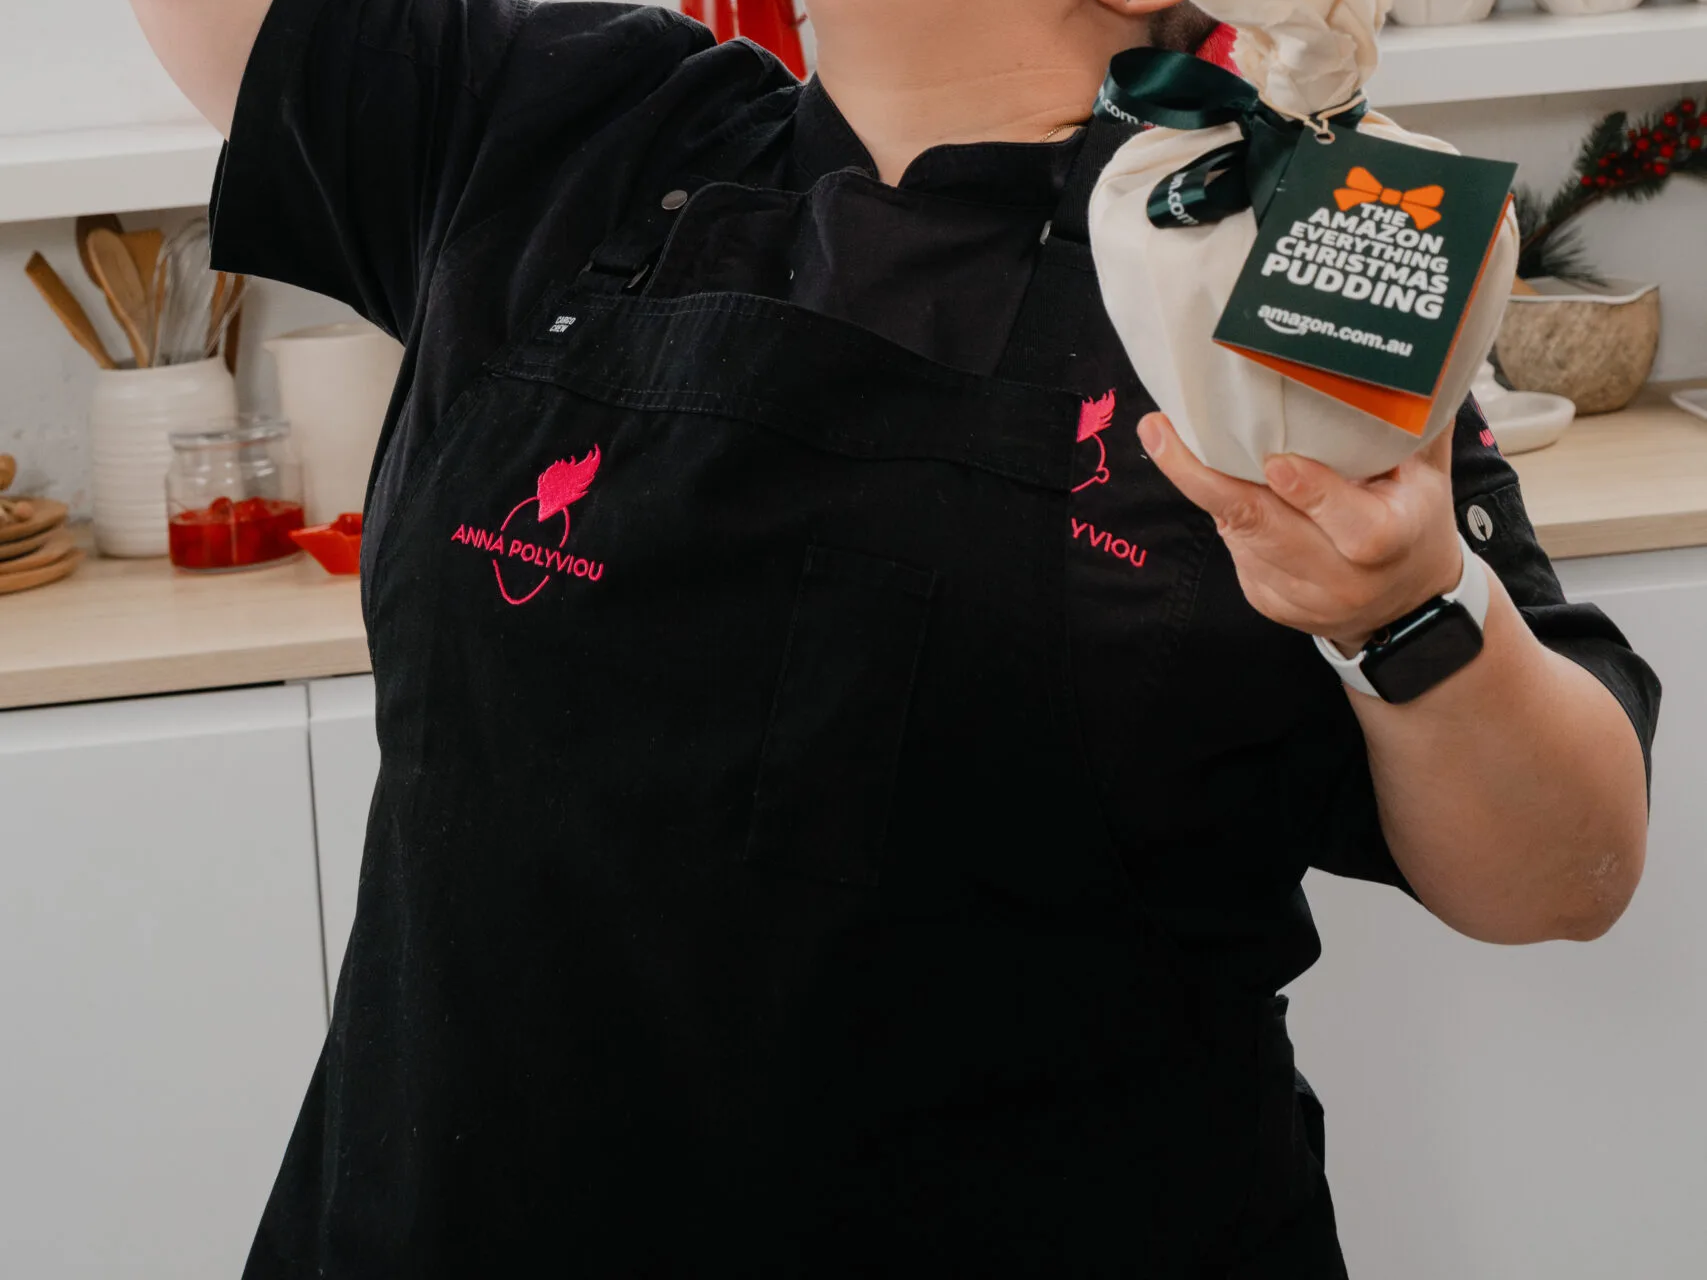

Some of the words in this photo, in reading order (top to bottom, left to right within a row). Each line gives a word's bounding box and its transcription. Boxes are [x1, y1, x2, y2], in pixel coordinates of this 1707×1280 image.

[1308, 207, 1444, 255] AMAZON
[1360, 202, 1409, 228] THE
[1275, 236, 1450, 294] CHRISTMAS
[1290, 220, 1449, 274] EVERYTHING
[1260, 252, 1445, 320] PUDDING
[1257, 304, 1414, 357] amazon.com.au
[451, 524, 505, 555] ANNA
[508, 539, 604, 582] POLYVIOU
